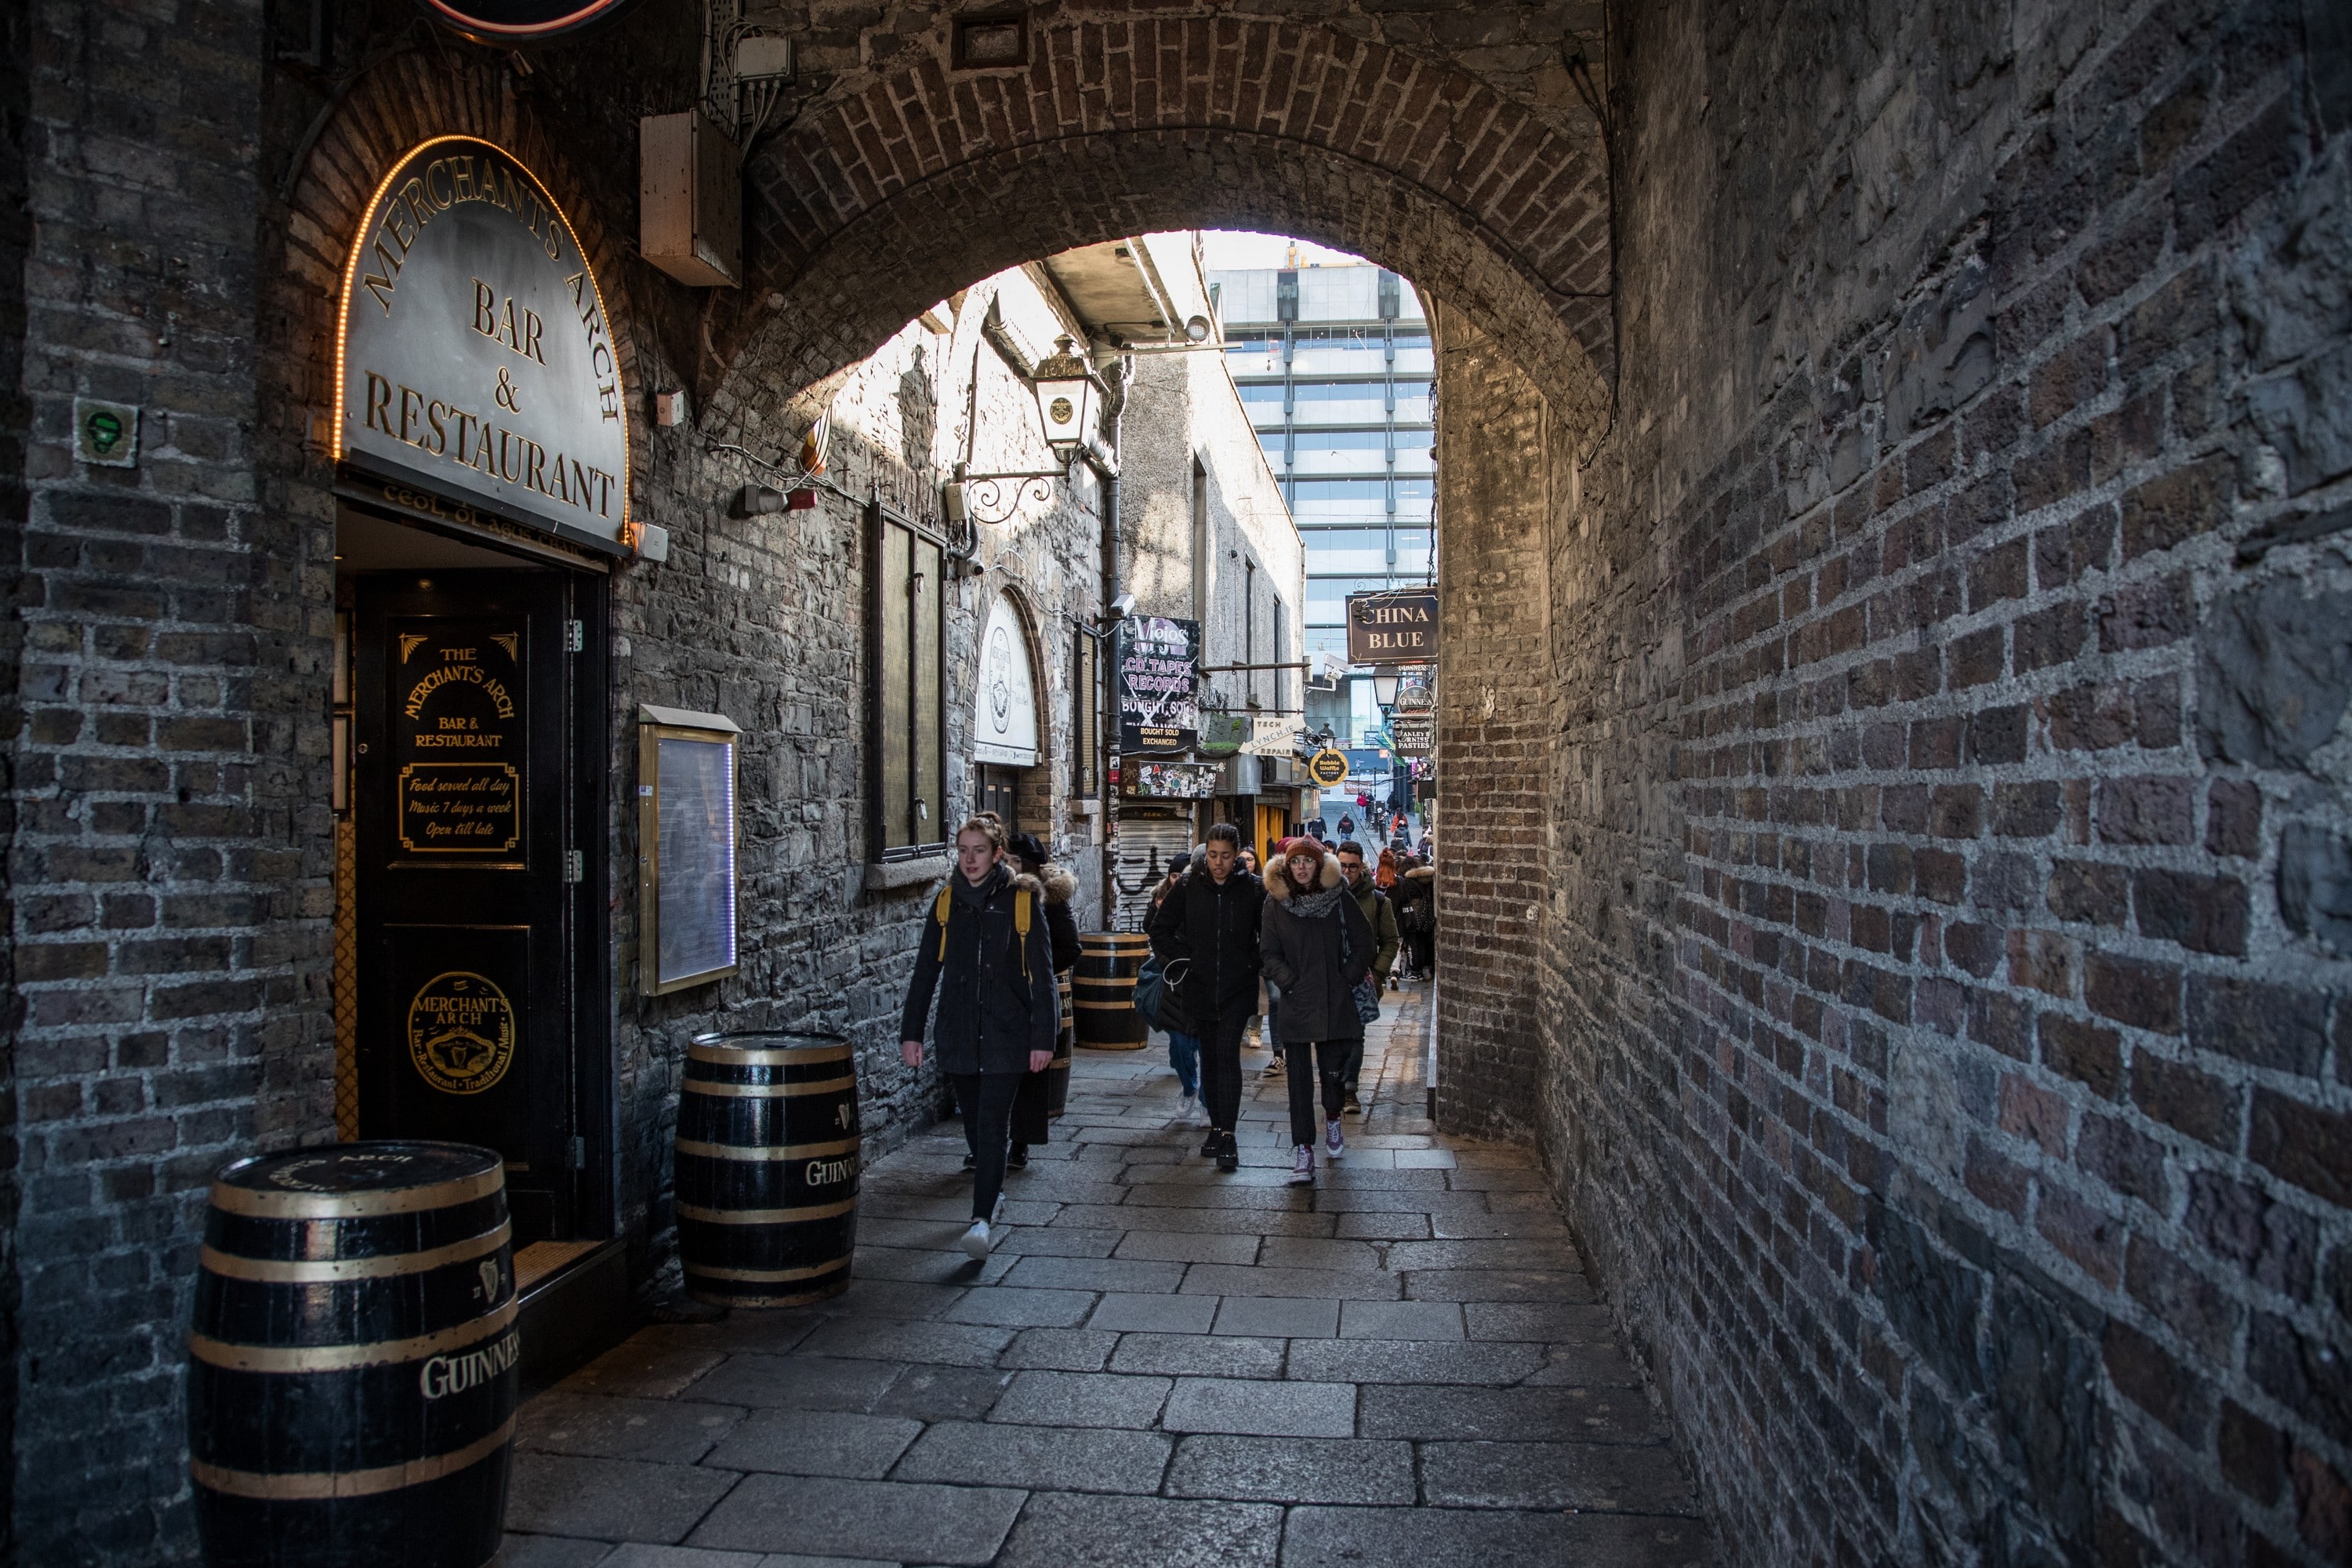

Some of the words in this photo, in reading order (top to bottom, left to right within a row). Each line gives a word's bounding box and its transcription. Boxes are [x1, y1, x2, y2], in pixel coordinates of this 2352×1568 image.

[471, 277, 546, 366] BAR
[564, 272, 619, 425] ARCH
[494, 366, 521, 415] &
[362, 369, 615, 520] RESTAURANT
[1368, 631, 1425, 649] BLUE
[440, 648, 477, 661] THE
[1149, 659, 1192, 677] TAPES
[1128, 674, 1190, 693] RECORDS
[482, 678, 515, 720] ARCH
[439, 717, 466, 729] BAR
[470, 717, 479, 729] &
[1140, 728, 1163, 736] BOUGHT
[1164, 728, 1180, 737] SOLD
[416, 735, 503, 747] RESTAURANT
[1142, 738, 1178, 746] EXCHANGED
[1251, 724, 1295, 749] LYNCH.IE
[408, 777, 438, 792] Food
[437, 777, 472, 792] served
[471, 777, 490, 792] all
[490, 778, 510, 796] day
[408, 800, 440, 814] Music
[442, 801, 450, 814] 7
[451, 800, 474, 817] days
[477, 805, 485, 814] a
[487, 800, 512, 814] week
[426, 822, 452, 839] Open
[455, 822, 475, 835] till
[474, 822, 495, 835] late
[414, 996, 509, 1012] MERCHANTS
[436, 1012, 482, 1025] ARCH
[413, 1028, 424, 1050] Bar
[498, 1022, 509, 1049] Music
[417, 1052, 457, 1089] Restaurant
[463, 1051, 508, 1090] Traditional
